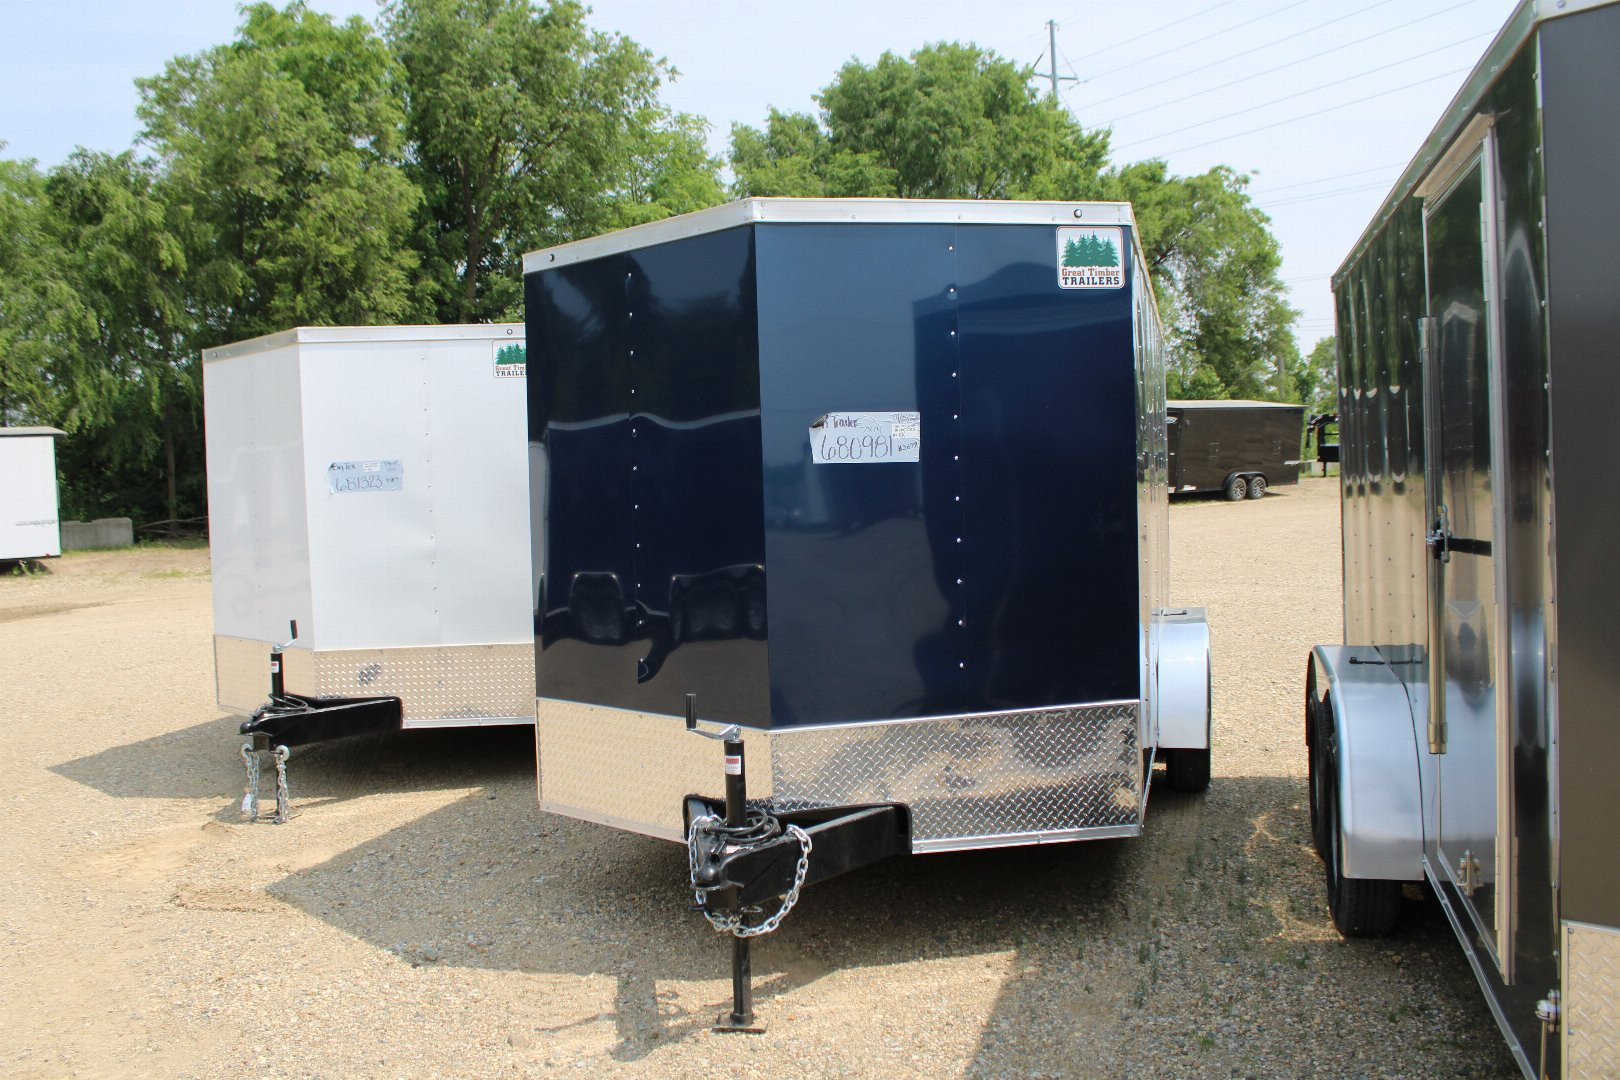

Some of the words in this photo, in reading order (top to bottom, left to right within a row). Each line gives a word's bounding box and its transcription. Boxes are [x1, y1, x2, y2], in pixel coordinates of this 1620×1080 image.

[1062, 268, 1085, 277] Great
[1088, 268, 1120, 277] Timber
[1062, 277, 1120, 286] TRAILERS
[821, 435, 893, 461] 680981
[335, 475, 383, 492] 681323
